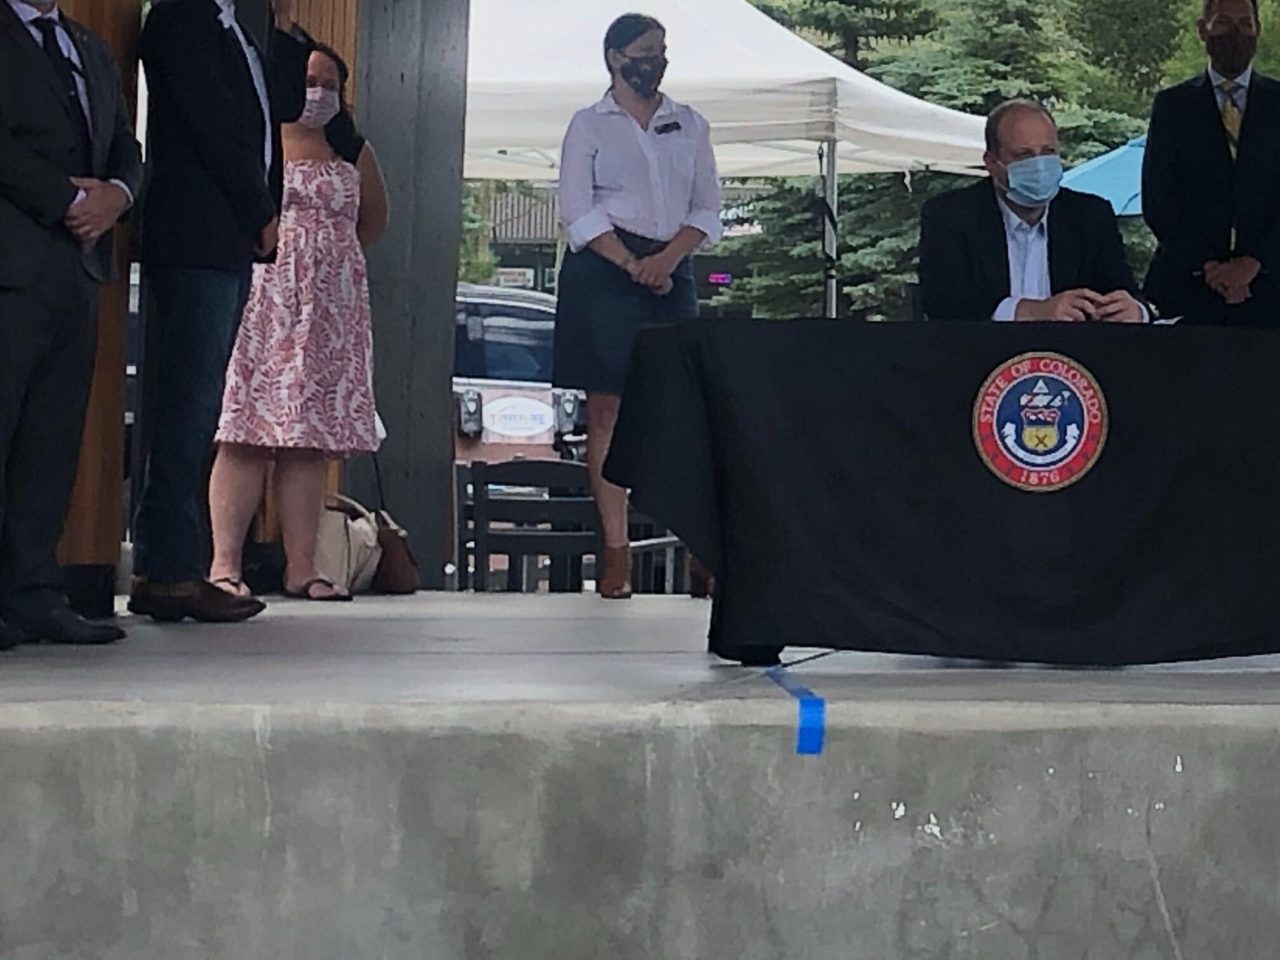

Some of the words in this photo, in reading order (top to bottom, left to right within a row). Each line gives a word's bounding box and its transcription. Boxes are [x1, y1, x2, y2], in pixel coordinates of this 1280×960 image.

[980, 377, 1009, 424] STATE
[1011, 361, 1031, 378] OF
[1039, 359, 1101, 424] COLORADO
[1020, 469, 1061, 486] 1876
